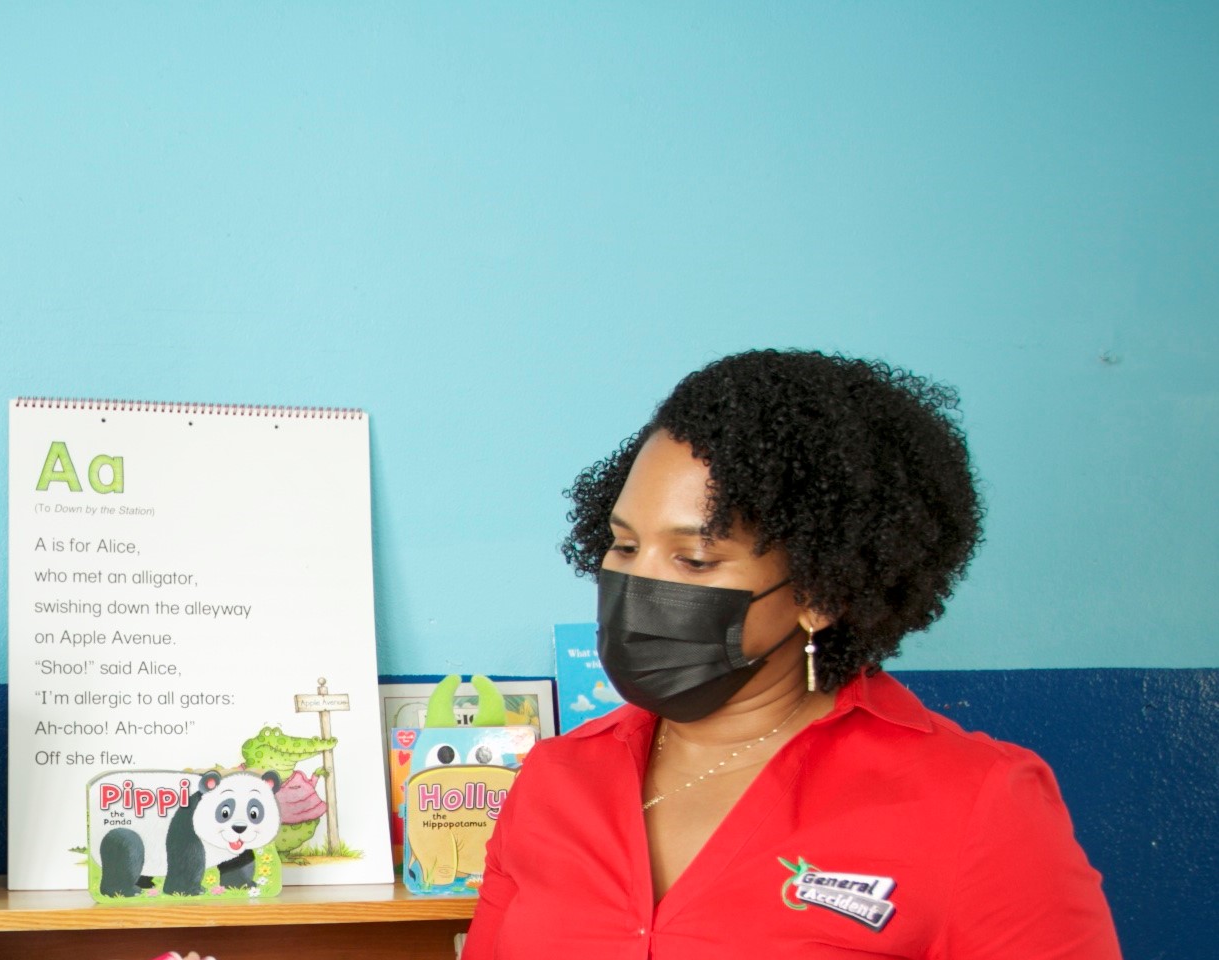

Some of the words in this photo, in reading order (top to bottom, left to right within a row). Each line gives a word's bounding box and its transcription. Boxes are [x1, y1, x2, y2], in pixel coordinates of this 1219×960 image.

[35, 503, 50, 513] (To
[55, 504, 82, 513] Down
[86, 505, 97, 515] by
[101, 506, 115, 514] the
[119, 506, 154, 516] Station)
[35, 537, 46, 551] A
[53, 538, 64, 552] is
[70, 538, 90, 552] for
[97, 539, 139, 555] Alice,
[35, 569, 67, 582] who
[73, 571, 102, 583] met
[108, 573, 126, 583] an
[132, 571, 197, 588] alligator,
[35, 600, 101, 617] swishing
[108, 600, 149, 614] down
[156, 601, 179, 614] the
[185, 602, 251, 619] alleyway
[35, 633, 54, 643] on
[60, 630, 106, 647] Apple
[112, 631, 175, 644] Avenue.
[100, 661, 131, 674] said
[138, 661, 181, 675] Alice,
[74, 691, 131, 708] allergic
[137, 692, 152, 704] to
[158, 692, 174, 705] all
[180, 693, 234, 708] gators:
[35, 721, 107, 735] Ah-choo!
[35, 751, 60, 765] Off
[66, 751, 94, 765] she
[100, 751, 135, 764] flew.
[99, 779, 190, 817] Pippi
[418, 783, 508, 820] Holly
[103, 818, 132, 826] Panda
[422, 820, 487, 830] Hippopotamus
[802, 873, 879, 895] General
[802, 888, 879, 921] Accident
